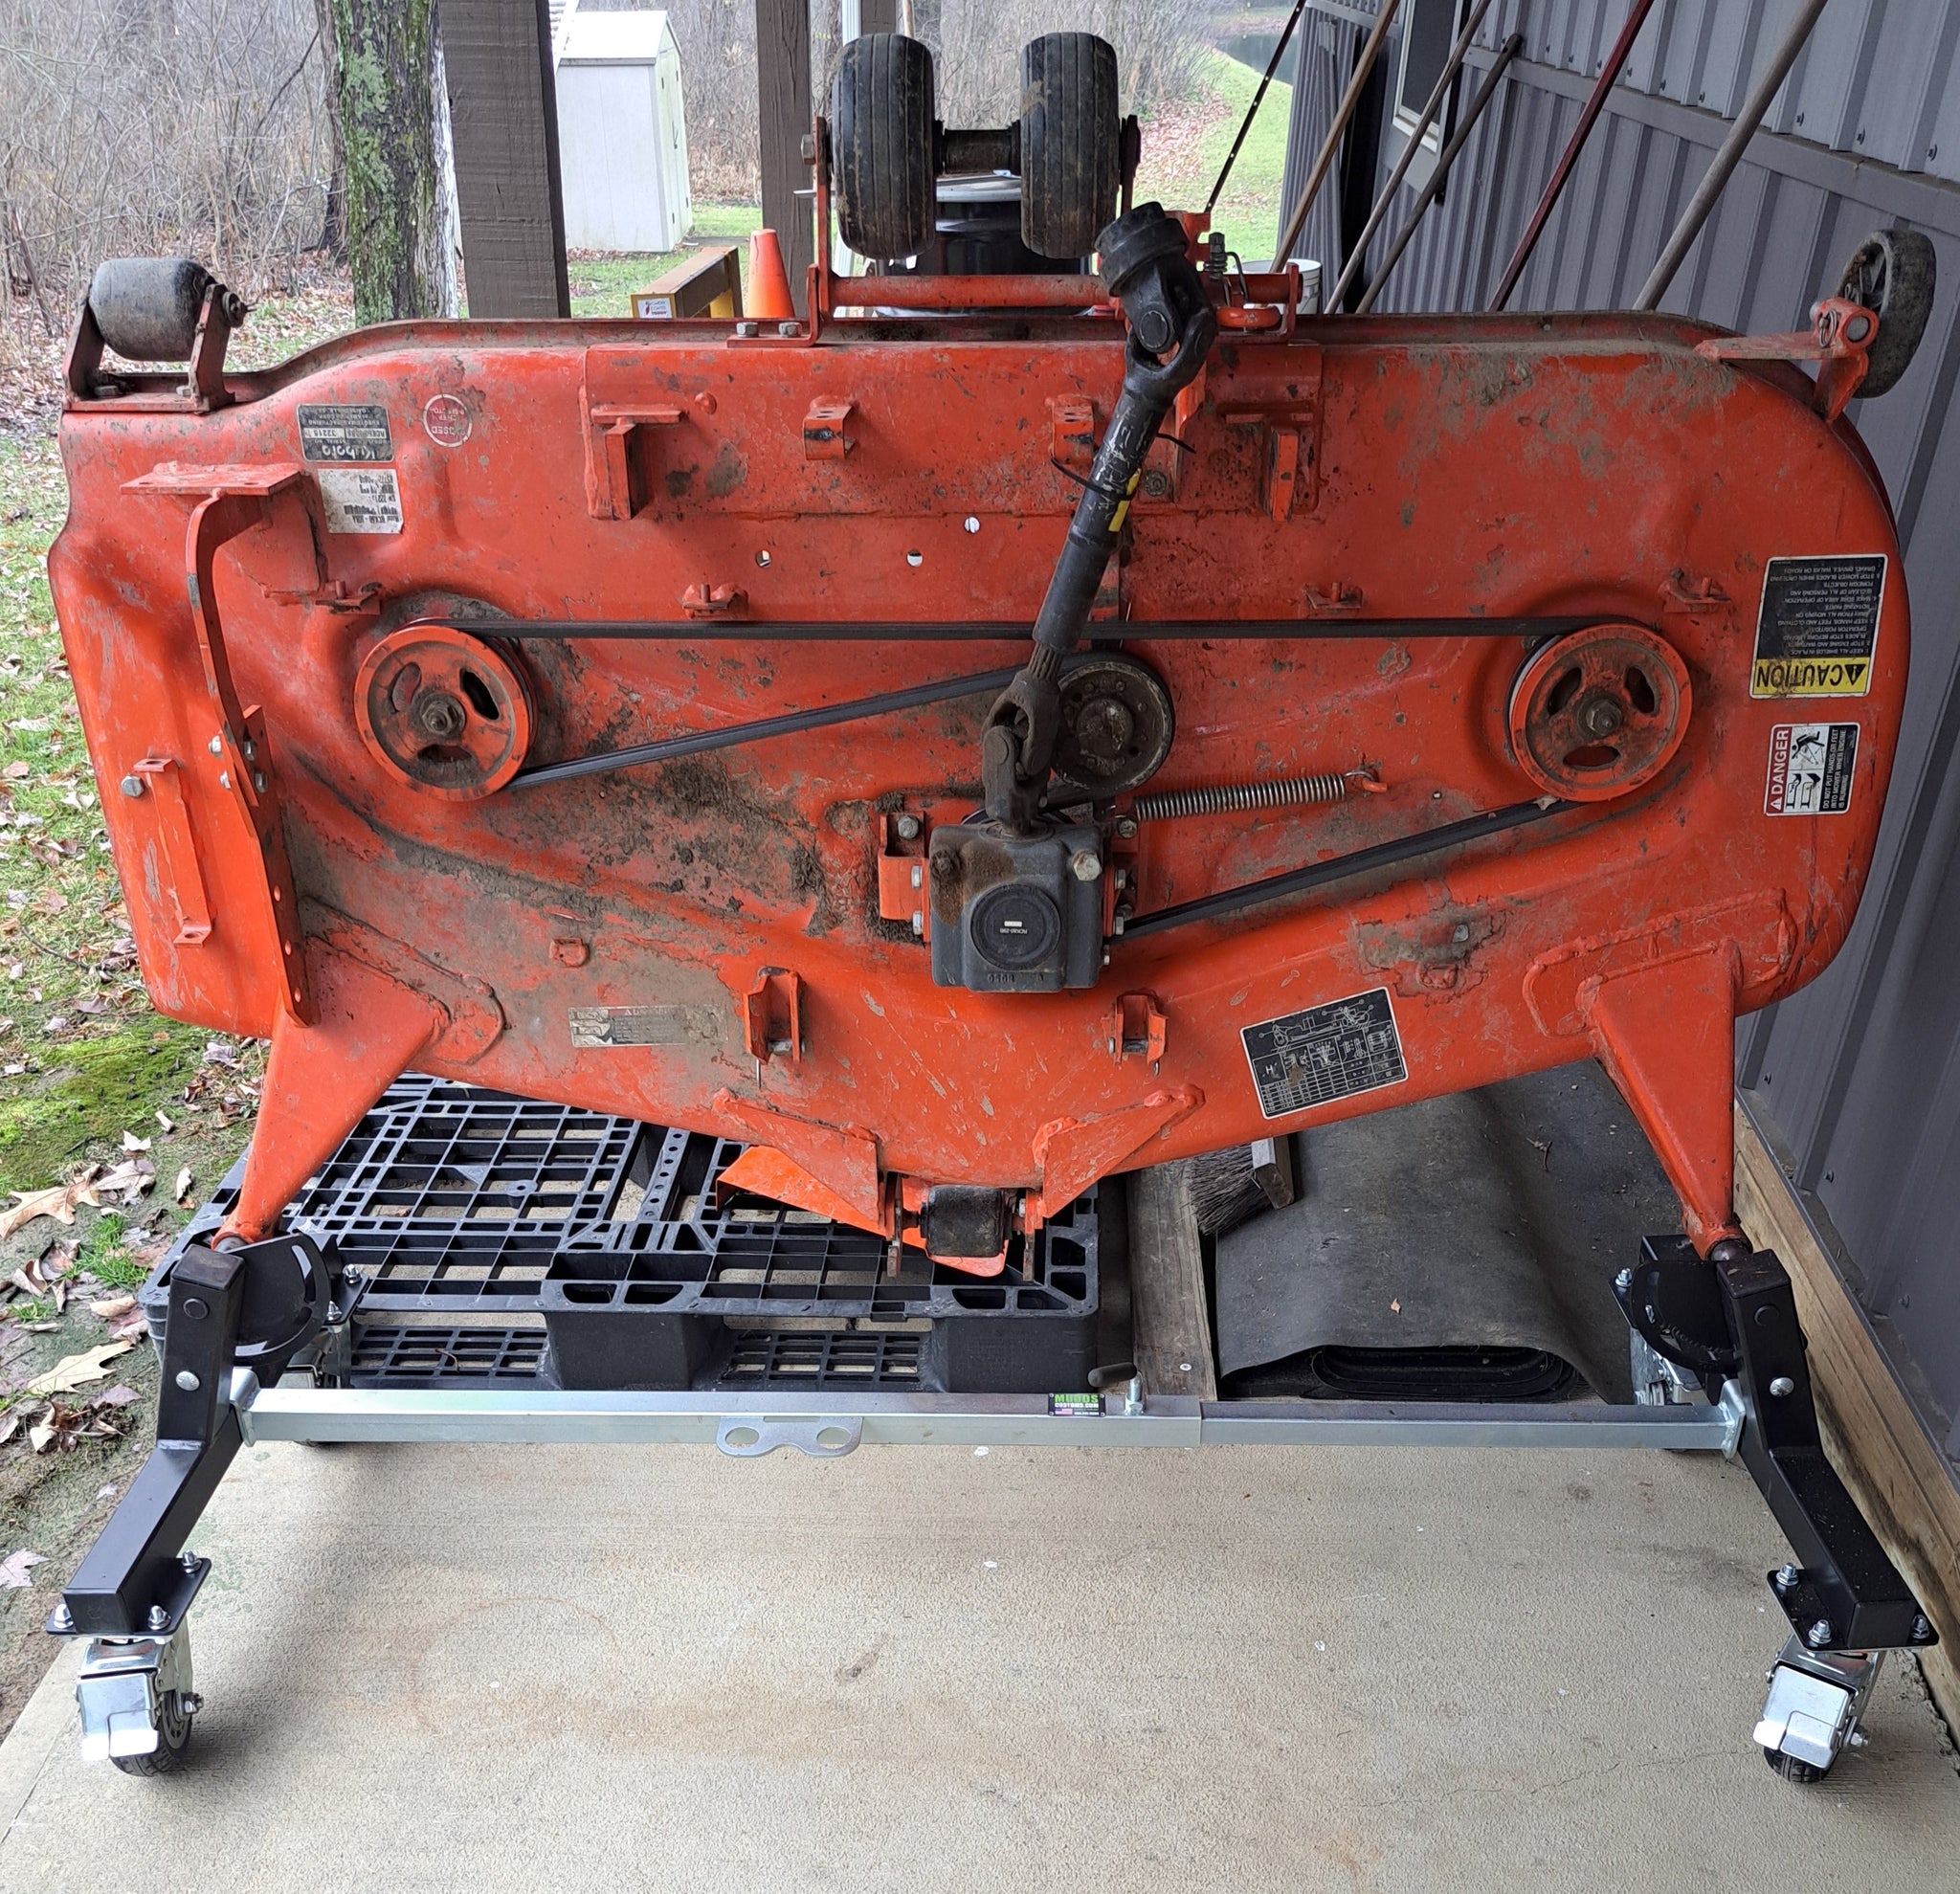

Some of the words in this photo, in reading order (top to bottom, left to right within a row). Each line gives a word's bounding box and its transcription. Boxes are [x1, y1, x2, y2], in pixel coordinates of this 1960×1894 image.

[322, 445, 375, 459] Kubota
[1756, 665, 1843, 687] CAUTION
[1830, 744, 1837, 753] OR
[1771, 730, 1789, 794] DANGER
[1827, 754, 1836, 773] HANDS
[1833, 771, 1841, 793] MOWER
[1838, 730, 1846, 751] ENGINE
[1823, 787, 1832, 799] NOT
[1823, 800, 1829, 809] DO
[1264, 1064, 1273, 1074] H
